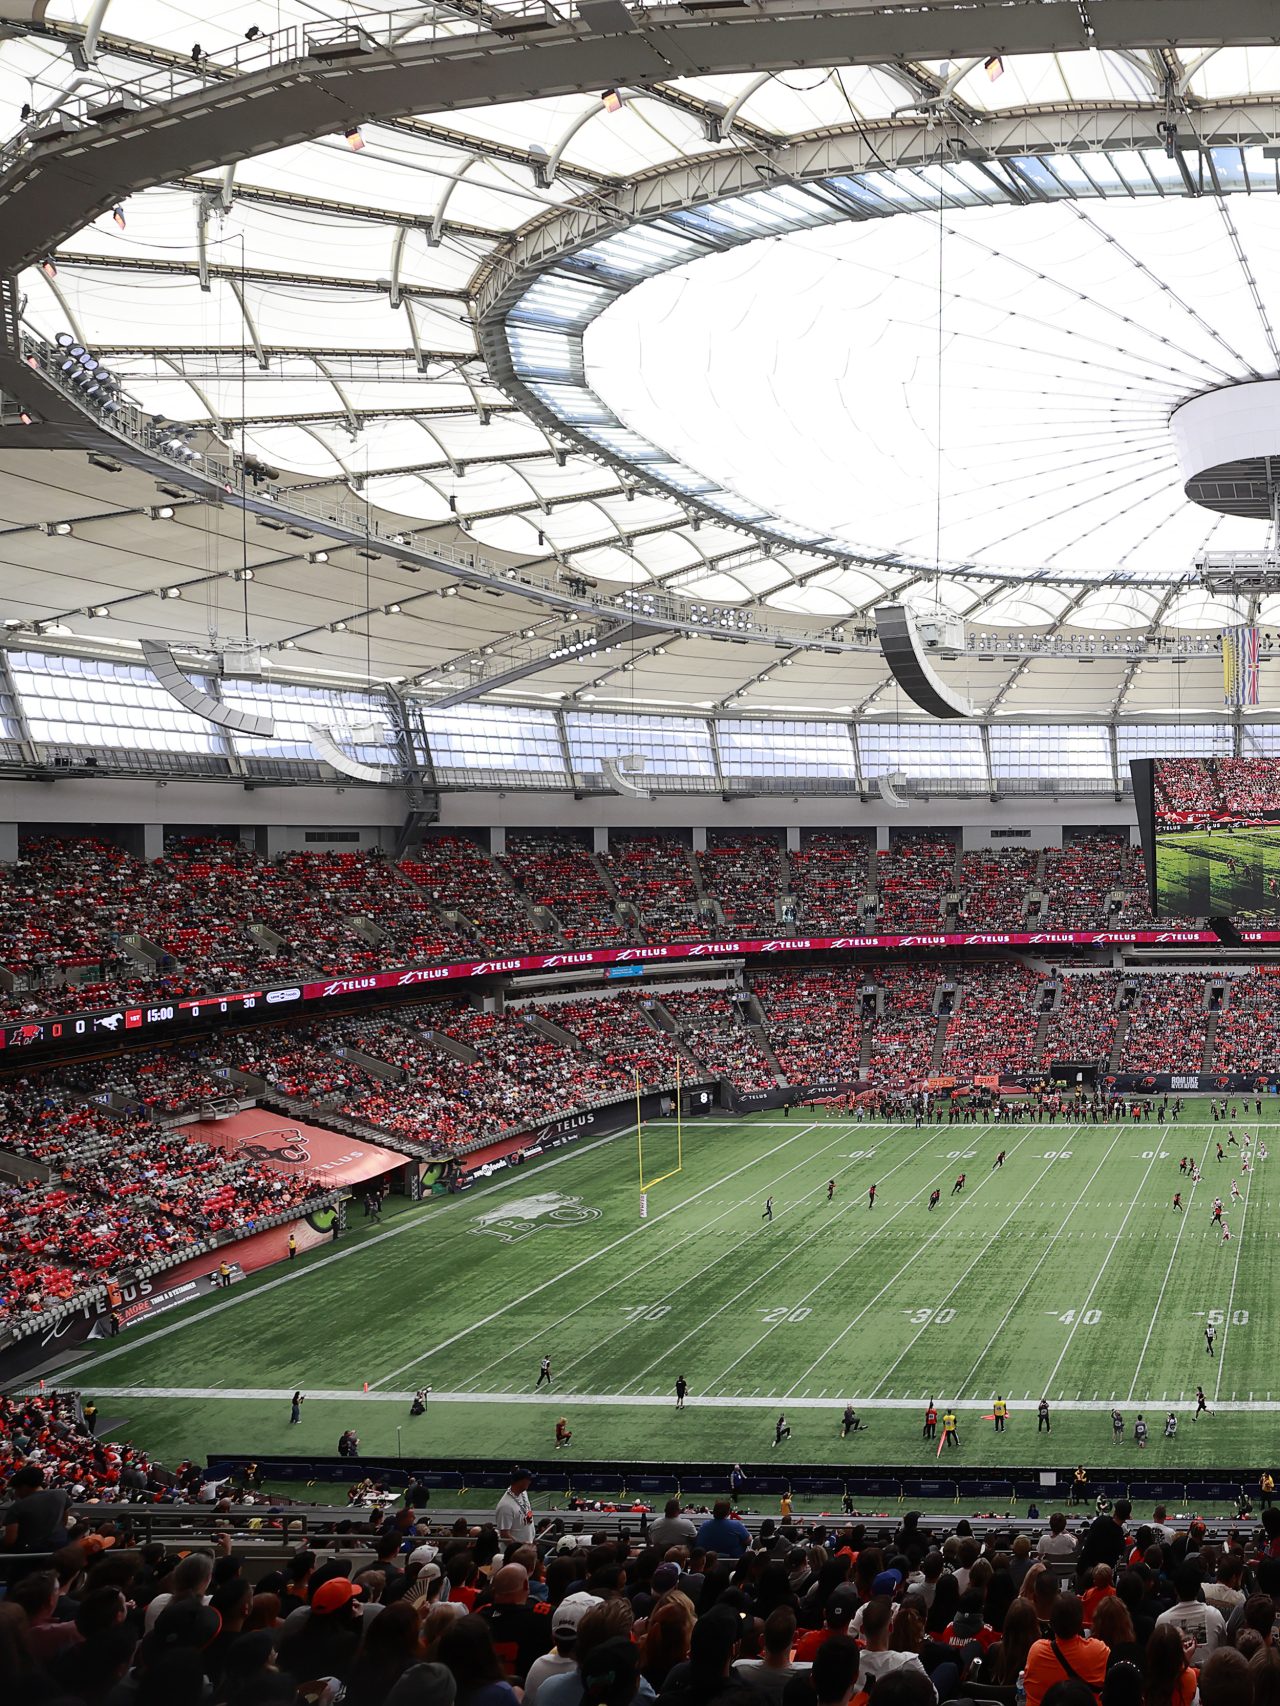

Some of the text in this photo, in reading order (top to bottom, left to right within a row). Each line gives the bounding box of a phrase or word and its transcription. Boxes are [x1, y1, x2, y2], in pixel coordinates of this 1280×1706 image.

[915, 935, 947, 945] TELUS
[980, 934, 1010, 943] TELUS
[1045, 933, 1074, 942] TELUS
[1107, 933, 1137, 941] TELUS
[1170, 932, 1200, 941] TELUS
[707, 942, 741, 951] TELUS
[779, 940, 811, 949] TELUS
[847, 938, 879, 946] TELUS
[635, 947, 668, 957] TELUS
[561, 953, 593, 964] TELUS
[489, 960, 521, 971] TELUS
[1250, 965, 1260, 975] 81
[416, 968, 449, 980] TELUS
[341, 977, 376, 990] TELUS
[220, 1002, 227, 1012] 0
[243, 998, 255, 1008] 30
[147, 1006, 174, 1022] 15:00
[192, 1006, 199, 1016] 0
[52, 1023, 62, 1037] 0
[75, 1020, 85, 1034] 0
[1171, 1076, 1198, 1084] ROAR LIKE
[700, 1092, 708, 1104] 8
[557, 1113, 595, 1132] TELUS
[849, 1150, 877, 1159] 10
[946, 1150, 977, 1159] 20
[1043, 1151, 1073, 1159] 30
[1140, 1150, 1169, 1159] 40
[81, 1280, 153, 1319] TEUS
[125, 1299, 150, 1318] MORE
[150, 1294, 163, 1305] THAN
[169, 1281, 197, 1299] BYSTANDER
[624, 1305, 672, 1320] 10
[761, 1307, 813, 1322] 20
[910, 1308, 957, 1324] 30
[1058, 1309, 1103, 1325] 40
[1206, 1309, 1248, 1325] 50
